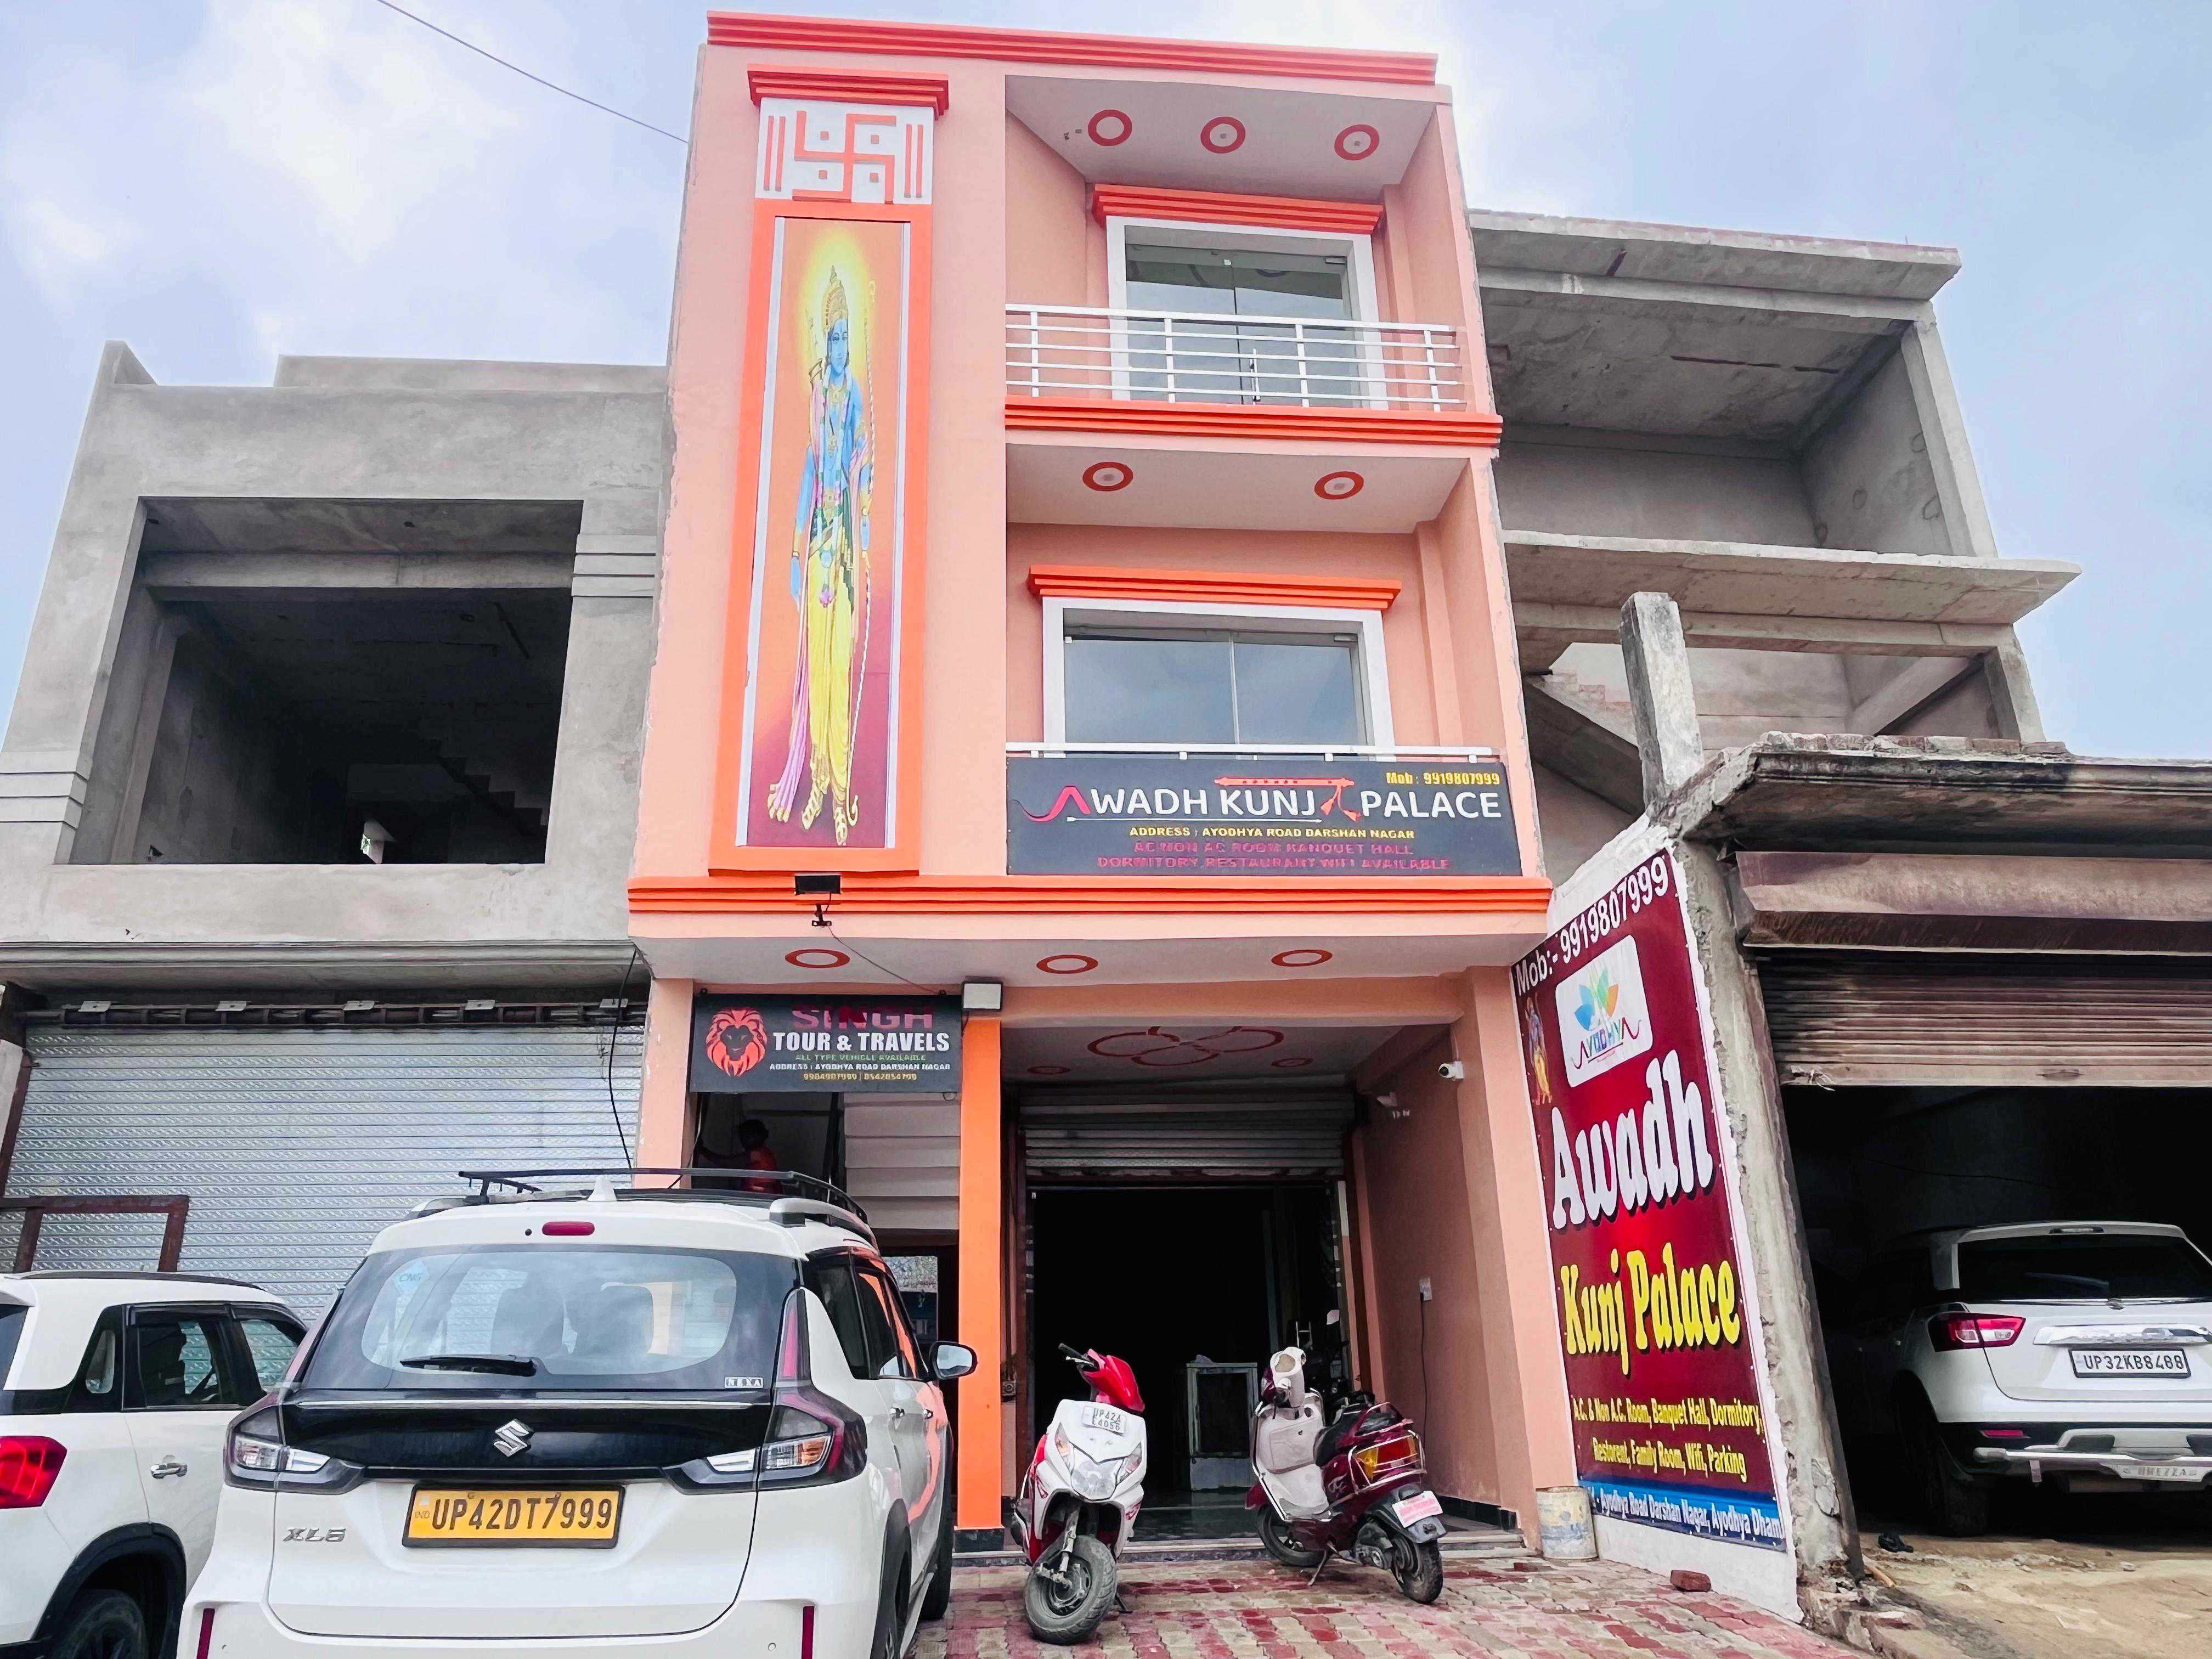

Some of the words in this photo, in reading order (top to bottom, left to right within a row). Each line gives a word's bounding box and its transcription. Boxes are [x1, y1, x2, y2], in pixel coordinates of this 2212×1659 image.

[1423, 772, 1500, 785] 9919807999
[1220, 789, 1316, 816] KUNJ
[1360, 790, 1502, 819] PALACE
[1130, 827, 1190, 837] ADDRESS
[1202, 827, 1263, 837] AYODHYA
[1266, 828, 1302, 837] ROAD
[1306, 828, 1366, 838] DARSHAN
[1371, 844, 1414, 855] HALL
[1560, 855, 1669, 964] 9919807999
[791, 1005, 933, 1029] SINGH
[772, 1032, 831, 1051] TOUR
[836, 1034, 853, 1052] &
[857, 1032, 950, 1052] TRAVELS
[1551, 1048, 1713, 1229] Awadh
[1560, 1248, 1629, 1376] Kunj
[1627, 1242, 1741, 1350] Palace
[1651, 1397, 1688, 1431] Banquet
[1706, 1443, 1747, 1483] Parking
[432, 1497, 613, 1531] UP42DT7999
[1711, 1502, 1752, 1541] Ayodhya
